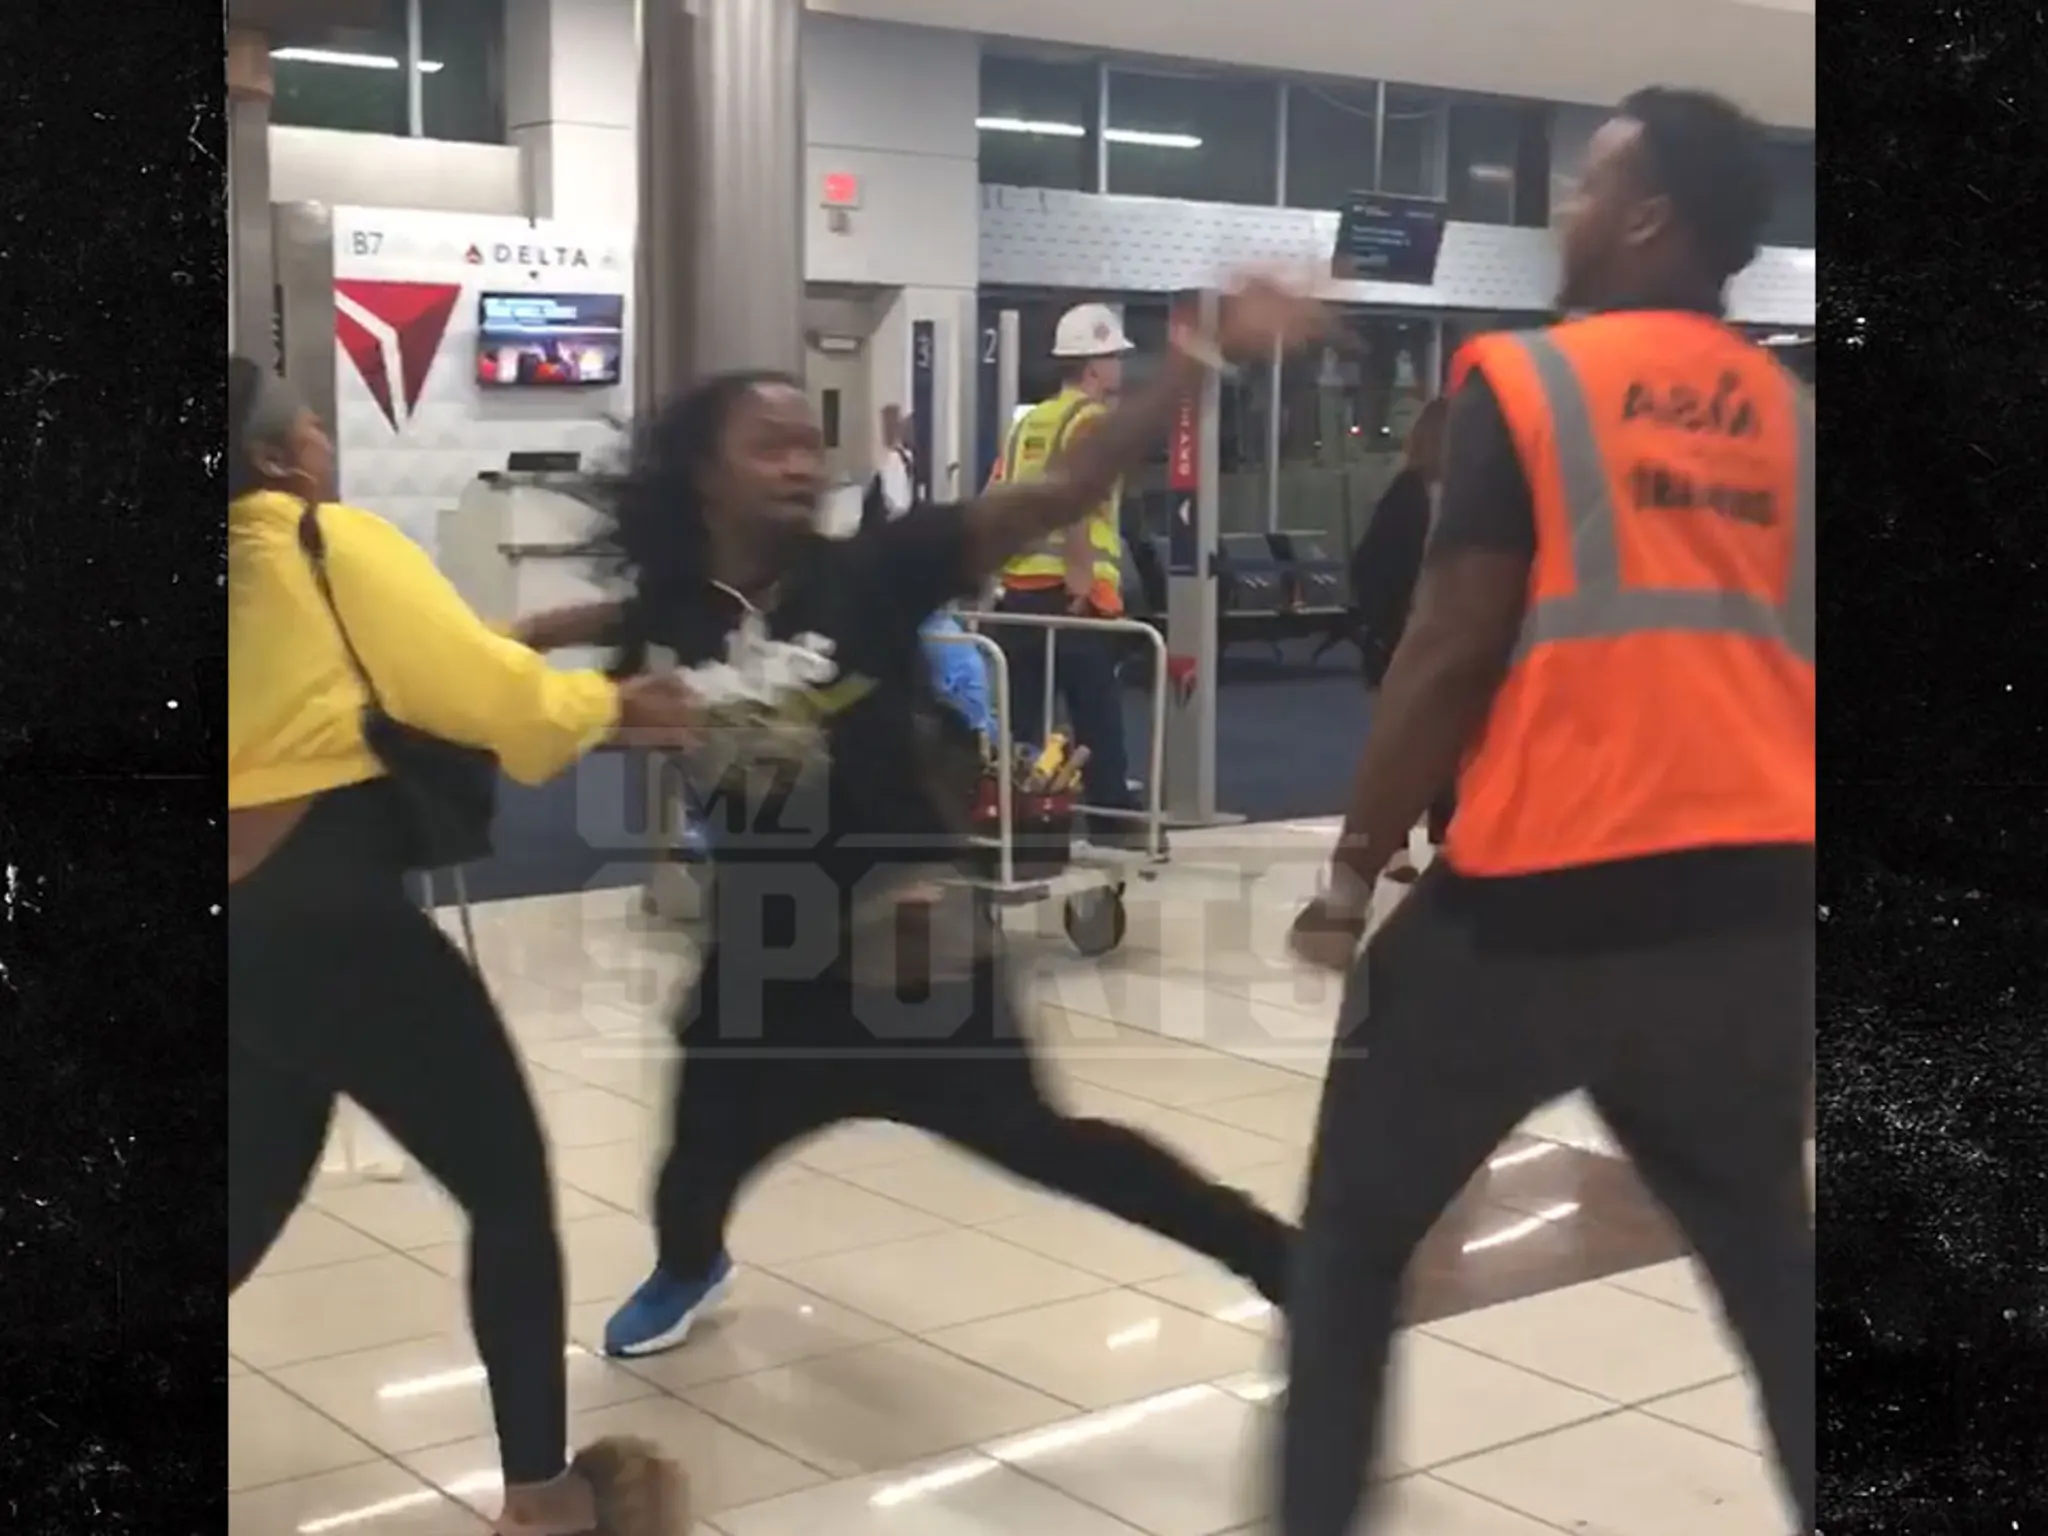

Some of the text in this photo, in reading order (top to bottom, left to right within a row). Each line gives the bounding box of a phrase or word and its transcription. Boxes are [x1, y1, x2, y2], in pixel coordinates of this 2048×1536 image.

[352, 230, 384, 256] B7
[493, 243, 588, 267] DELTA
[982, 327, 997, 364] 2
